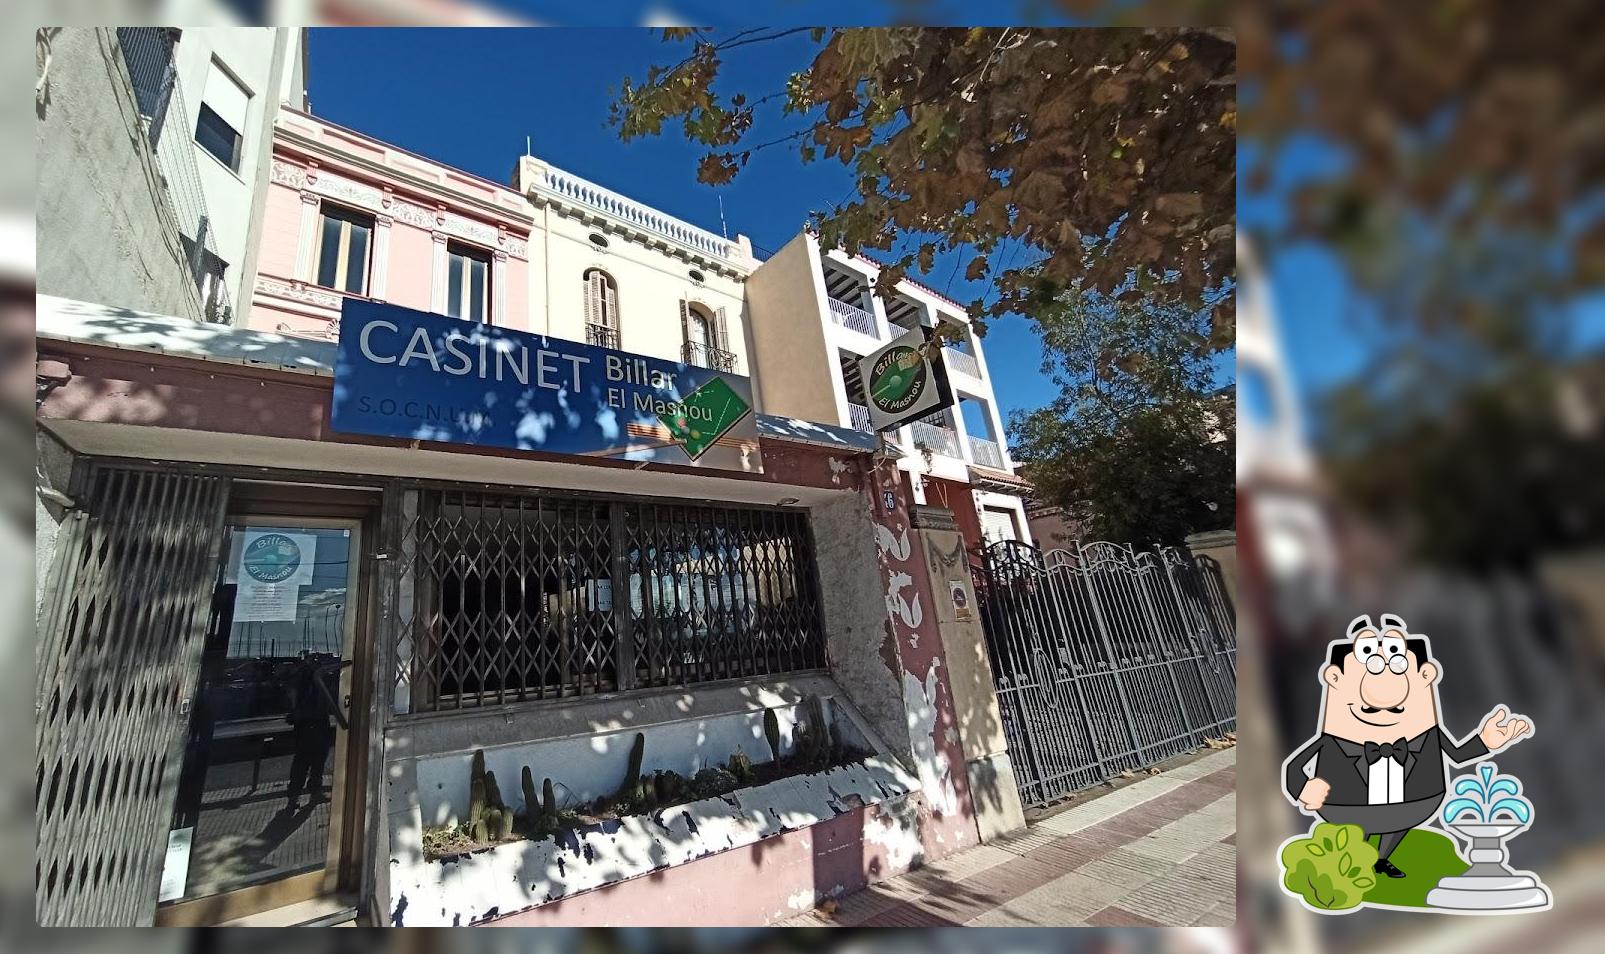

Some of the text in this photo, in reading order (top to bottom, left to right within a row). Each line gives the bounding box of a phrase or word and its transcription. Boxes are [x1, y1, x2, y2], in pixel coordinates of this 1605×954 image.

[359, 320, 591, 393] CASINET
[605, 354, 677, 391] Billar
[608, 387, 713, 422] El Masnou
[879, 380, 922, 410] El Masnou
